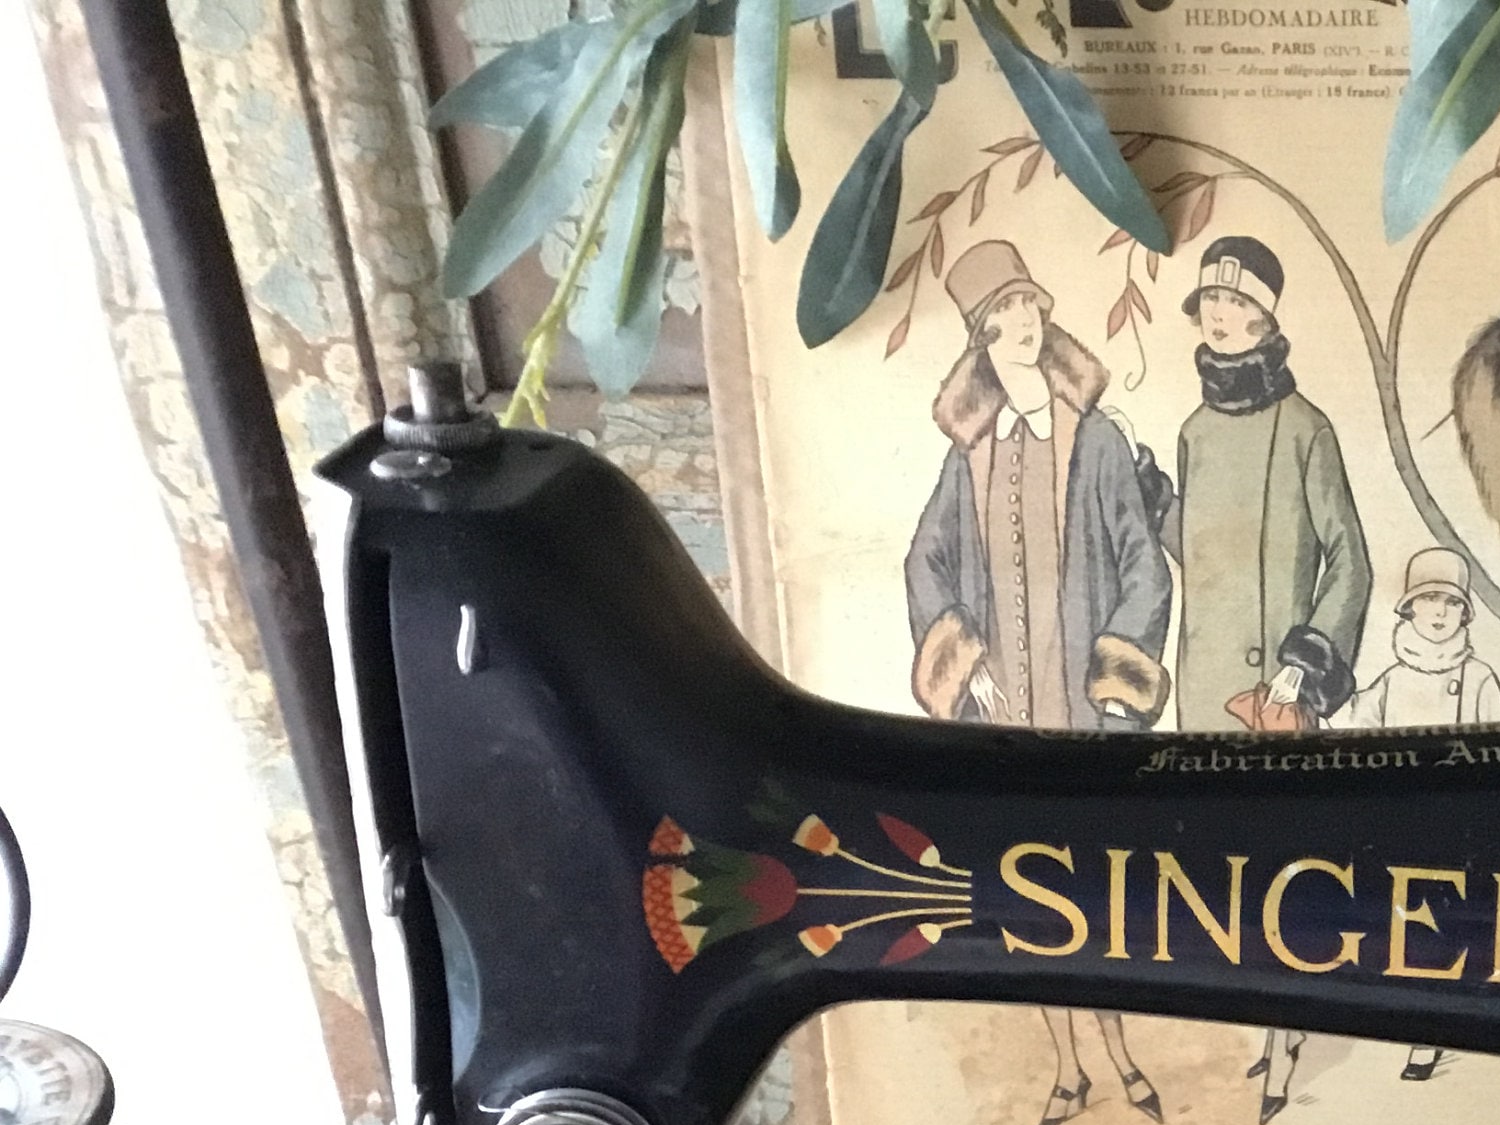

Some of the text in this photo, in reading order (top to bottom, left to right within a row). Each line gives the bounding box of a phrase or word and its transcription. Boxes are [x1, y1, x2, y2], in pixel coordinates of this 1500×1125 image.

[1185, 9, 1379, 27] HEBDOMADAIRE
[1084, 40, 1157, 53] BUREAUX
[1272, 42, 1316, 55] PARIS
[1135, 745, 1420, 779] Fabrication
